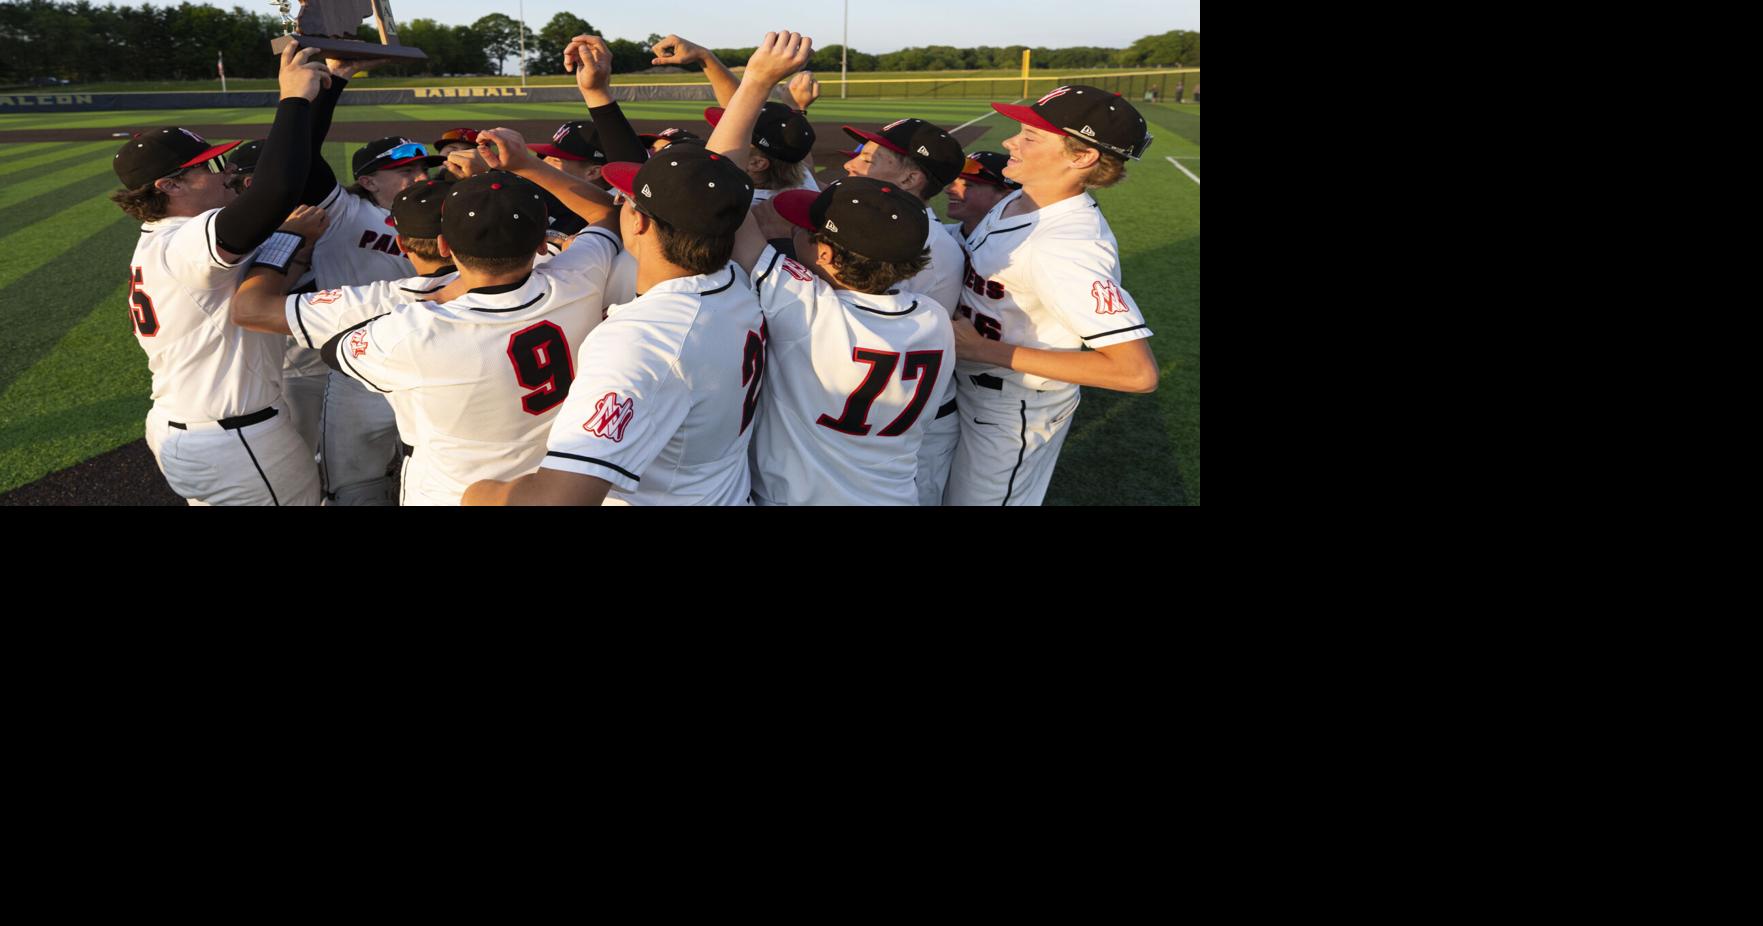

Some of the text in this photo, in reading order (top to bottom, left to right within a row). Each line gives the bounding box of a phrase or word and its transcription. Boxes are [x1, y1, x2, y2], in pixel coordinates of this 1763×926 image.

[414, 86, 527, 98] BASEBALL
[128, 265, 160, 337] 5
[963, 262, 1005, 300] ERS
[506, 319, 576, 416] 9
[739, 318, 768, 437] 2
[815, 346, 944, 437] 17
